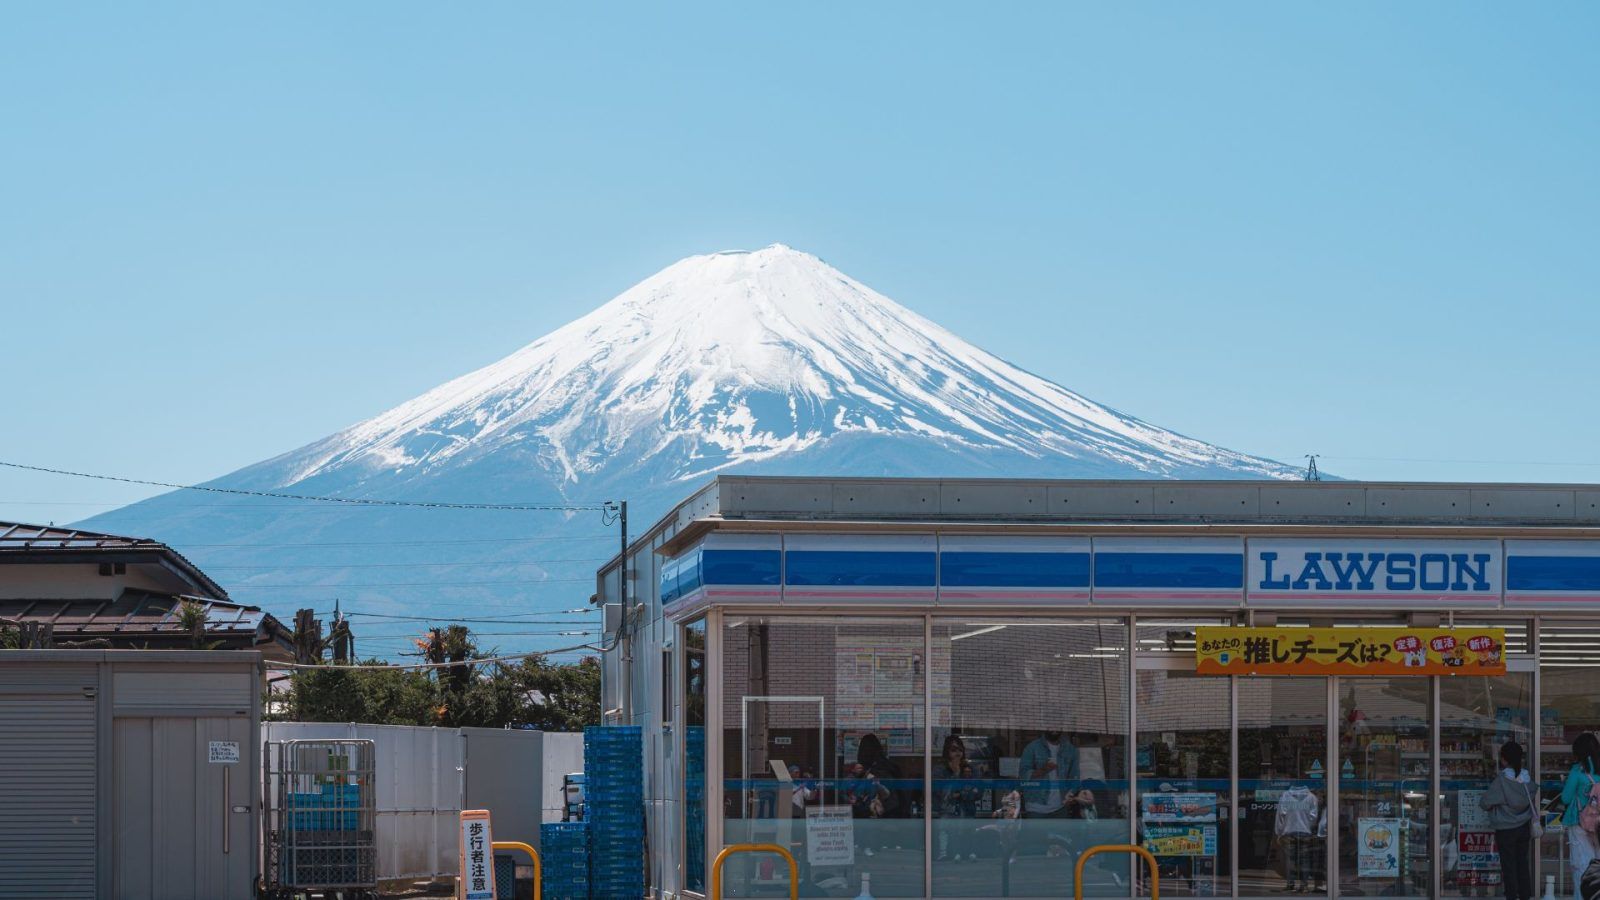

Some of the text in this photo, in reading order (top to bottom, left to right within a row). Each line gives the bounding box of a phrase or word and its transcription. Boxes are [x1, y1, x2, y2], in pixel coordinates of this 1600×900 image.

[1260, 551, 1491, 591] LAWSON
[1201, 637, 1240, 651] あなたの
[1243, 636, 1392, 664] 推しチーズは?
[1395, 637, 1418, 650] 定番
[1432, 637, 1454, 650] 復活
[1469, 638, 1491, 651] 新作
[1377, 801, 1391, 811] 24
[1464, 833, 1496, 845] ATM
[469, 822, 486, 891] 歩行者注意
